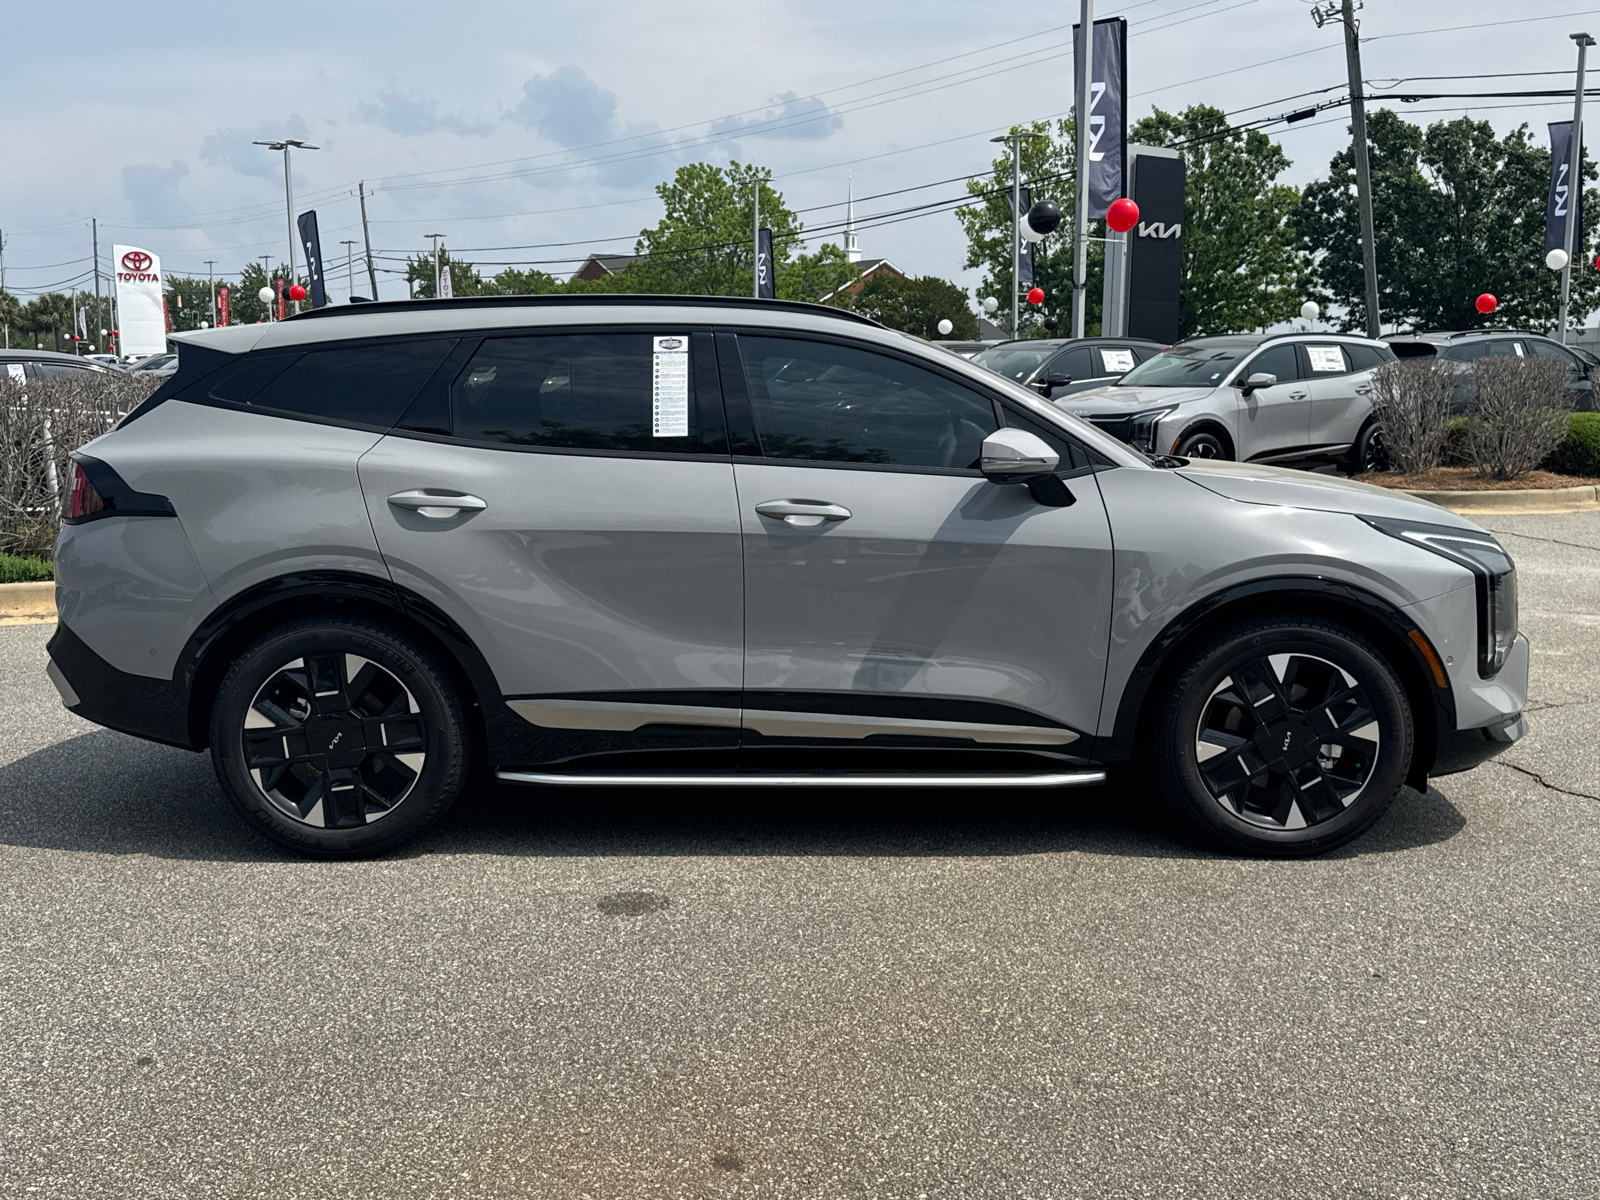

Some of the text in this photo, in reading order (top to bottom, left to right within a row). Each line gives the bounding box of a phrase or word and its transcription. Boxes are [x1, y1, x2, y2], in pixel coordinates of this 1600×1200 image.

[1089, 82, 1106, 161] KIA
[1554, 163, 1569, 217] KIA
[1138, 221, 1182, 240] KIA
[117, 272, 159, 283] TOYOTA
[350, 635, 414, 673] MICHELIN
[1282, 731, 1292, 751] KIA
